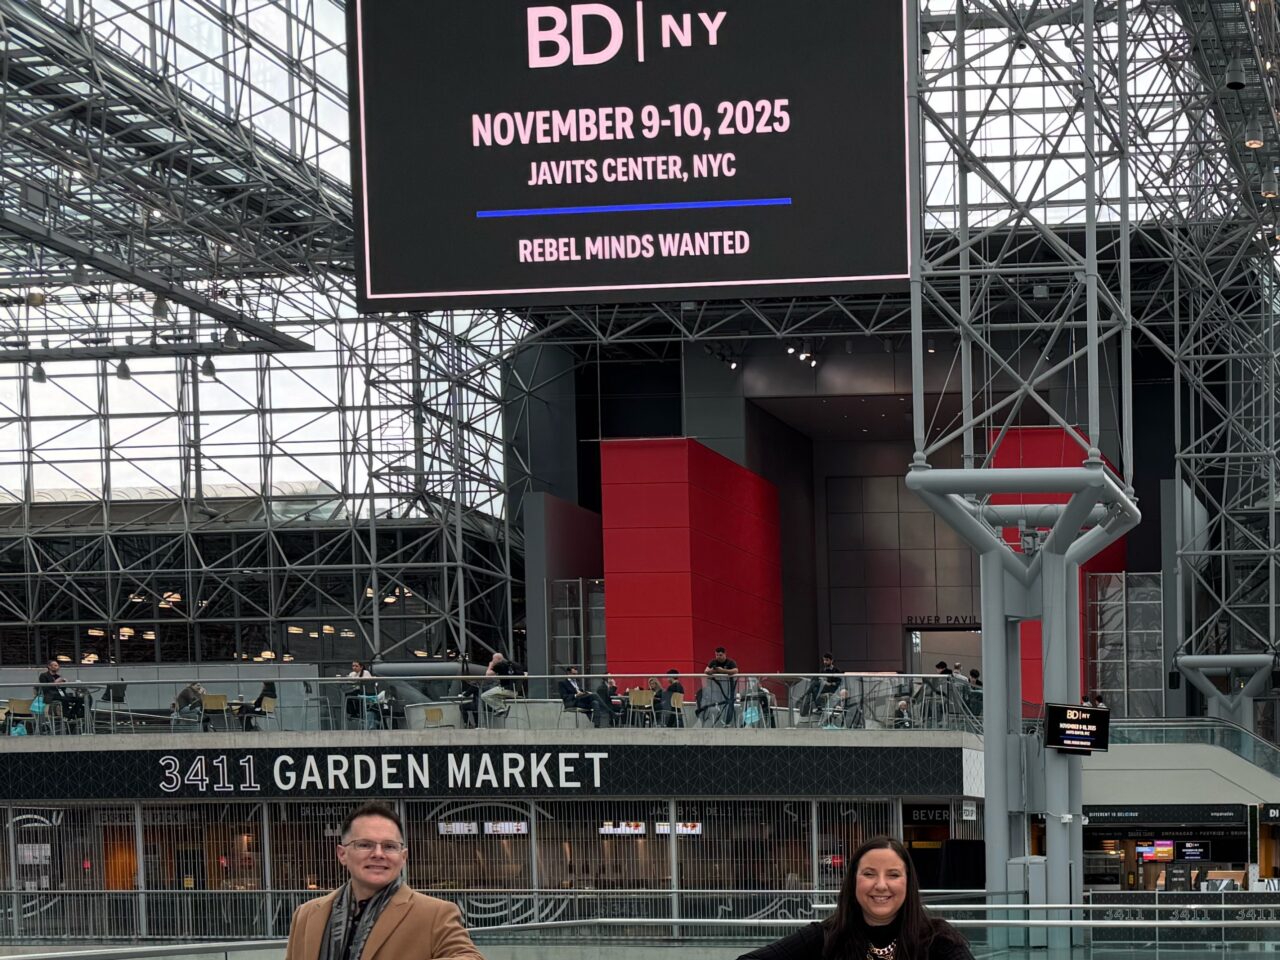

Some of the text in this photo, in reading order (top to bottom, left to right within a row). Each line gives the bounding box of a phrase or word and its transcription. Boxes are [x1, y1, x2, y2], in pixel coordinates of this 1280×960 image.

[472, 99, 790, 147] NOVEMBER 9-10, 2025
[528, 153, 736, 186] JAVITS CENTER, NYC
[518, 231, 750, 263] REBEL MINDS WANTED
[907, 616, 940, 624] RIVER
[158, 752, 609, 792] 3411 GARDEN MARKET
[648, 806, 698, 817] JACB'S
[1269, 808, 1279, 818] DI
[1103, 908, 1145, 921] 3411
[1169, 908, 1211, 921] 3411
[1235, 908, 1277, 920] 3411
